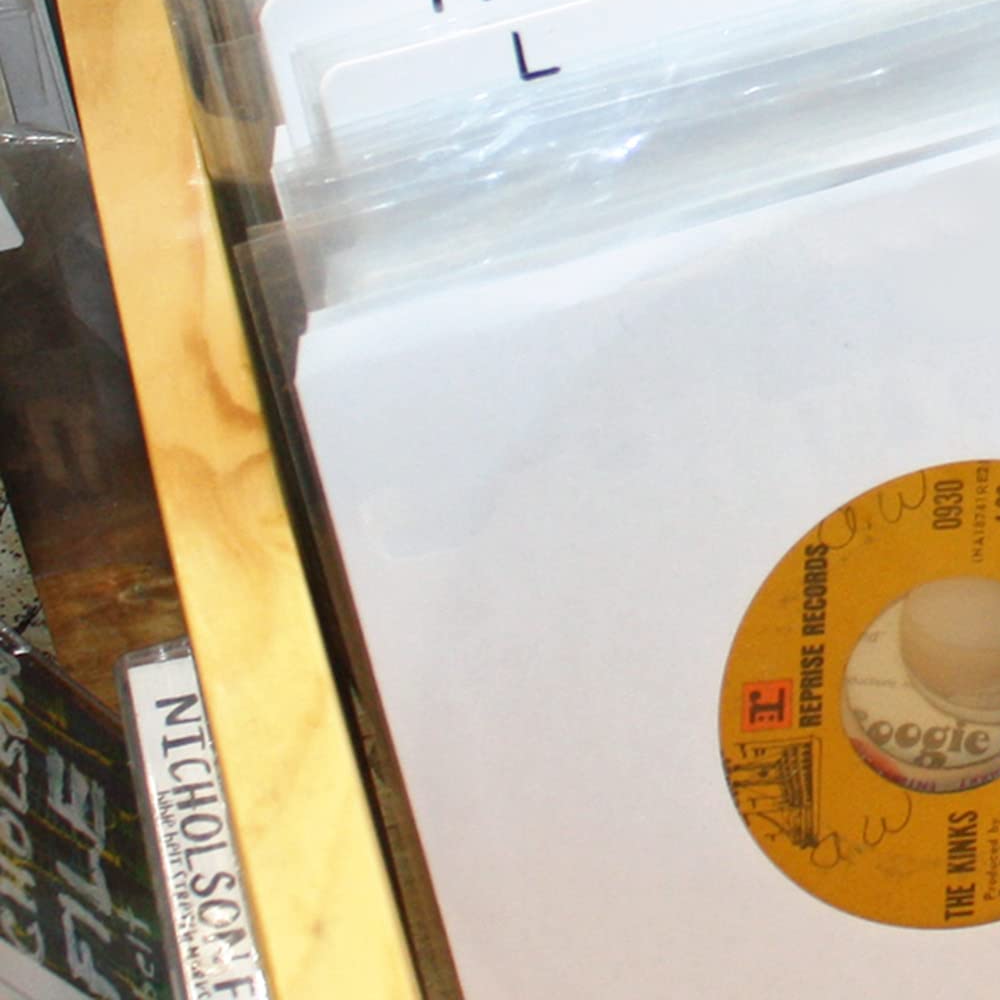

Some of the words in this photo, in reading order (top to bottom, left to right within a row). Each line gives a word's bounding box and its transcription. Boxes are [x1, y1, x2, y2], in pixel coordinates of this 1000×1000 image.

[511, 29, 562, 82] L
[932, 478, 964, 531] 0930
[802, 542, 829, 637] RECORDS
[799, 643, 825, 729] REPRISE
[946, 809, 979, 875] KINKS
[944, 881, 976, 922] THE
